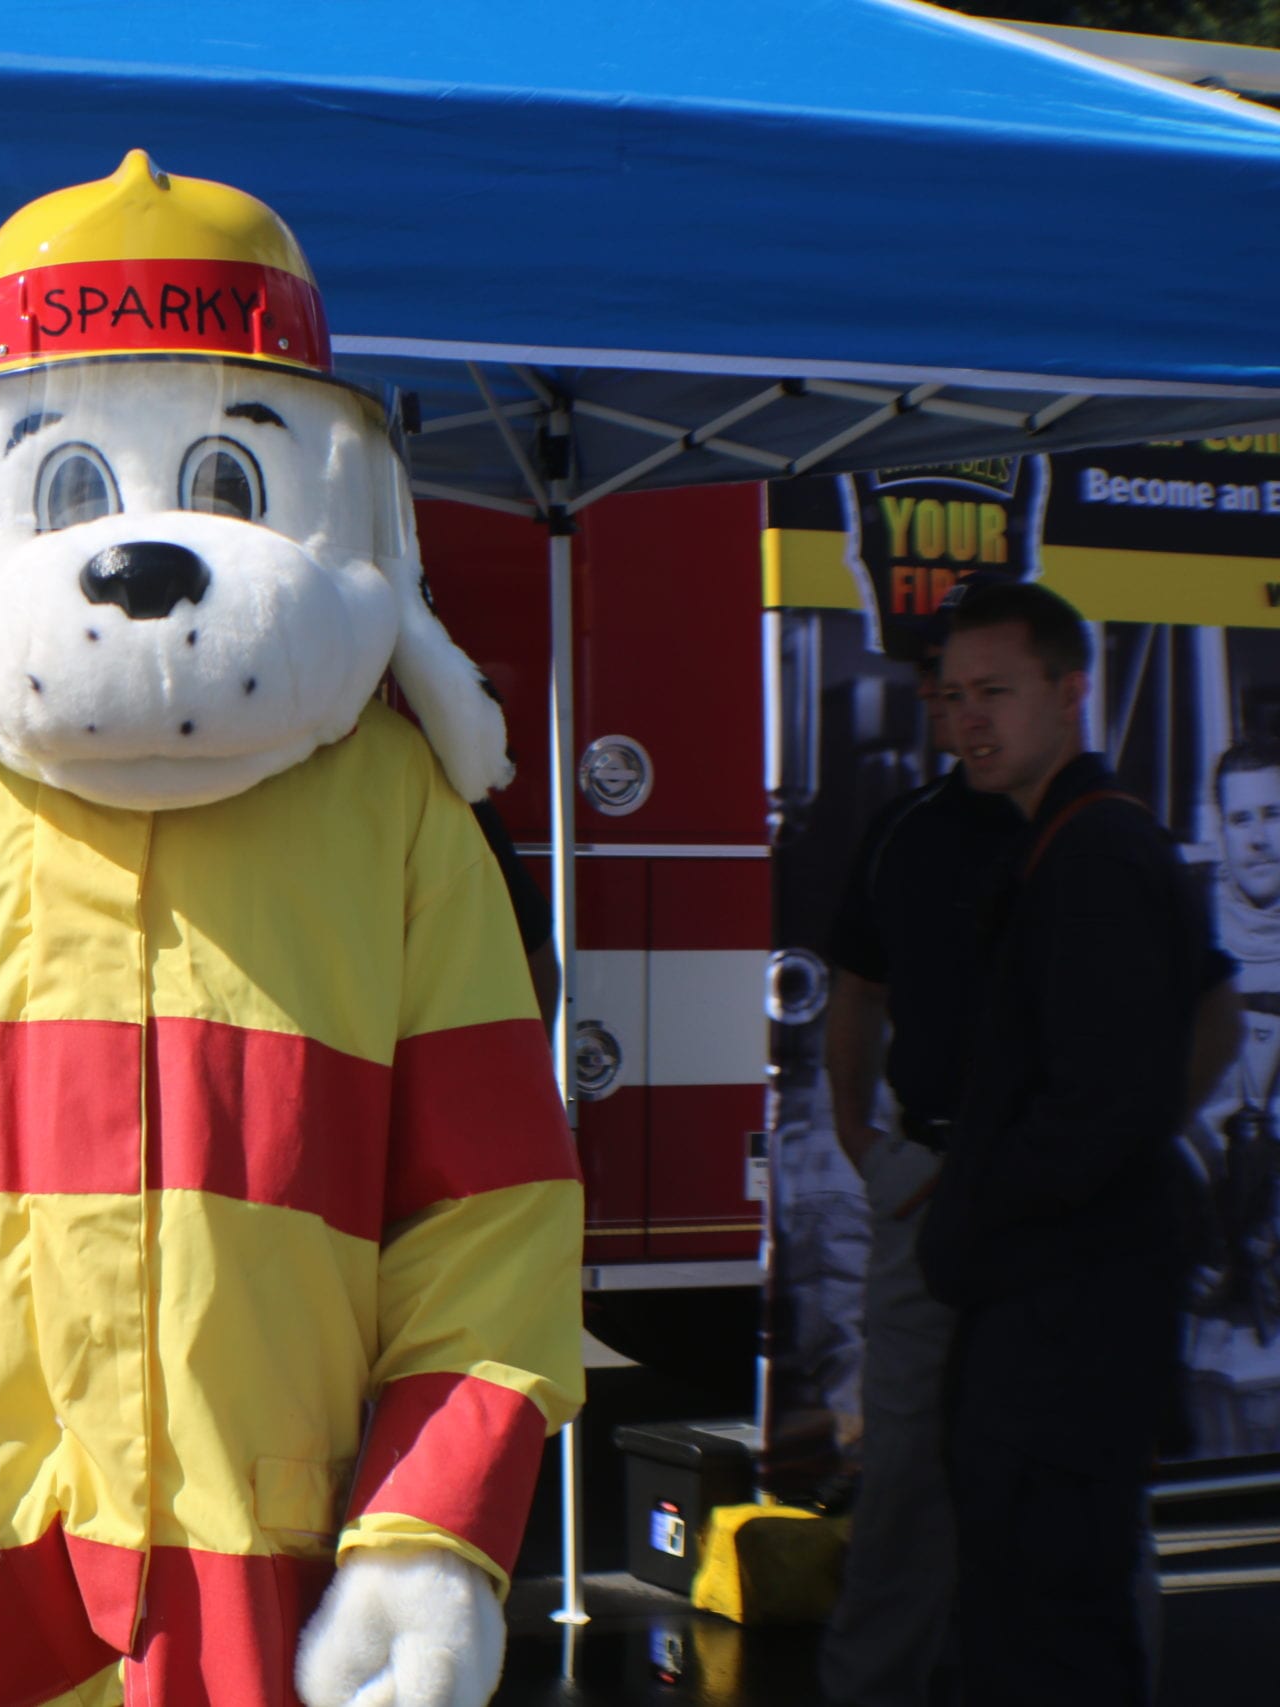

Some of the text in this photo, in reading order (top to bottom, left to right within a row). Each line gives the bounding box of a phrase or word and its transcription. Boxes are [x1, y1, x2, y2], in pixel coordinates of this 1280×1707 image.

[40, 284, 261, 336] SPARKY
[1082, 466, 1216, 510] Become
[1218, 482, 1261, 513] an
[879, 495, 1009, 564] YOUR
[890, 565, 978, 616] FIR
